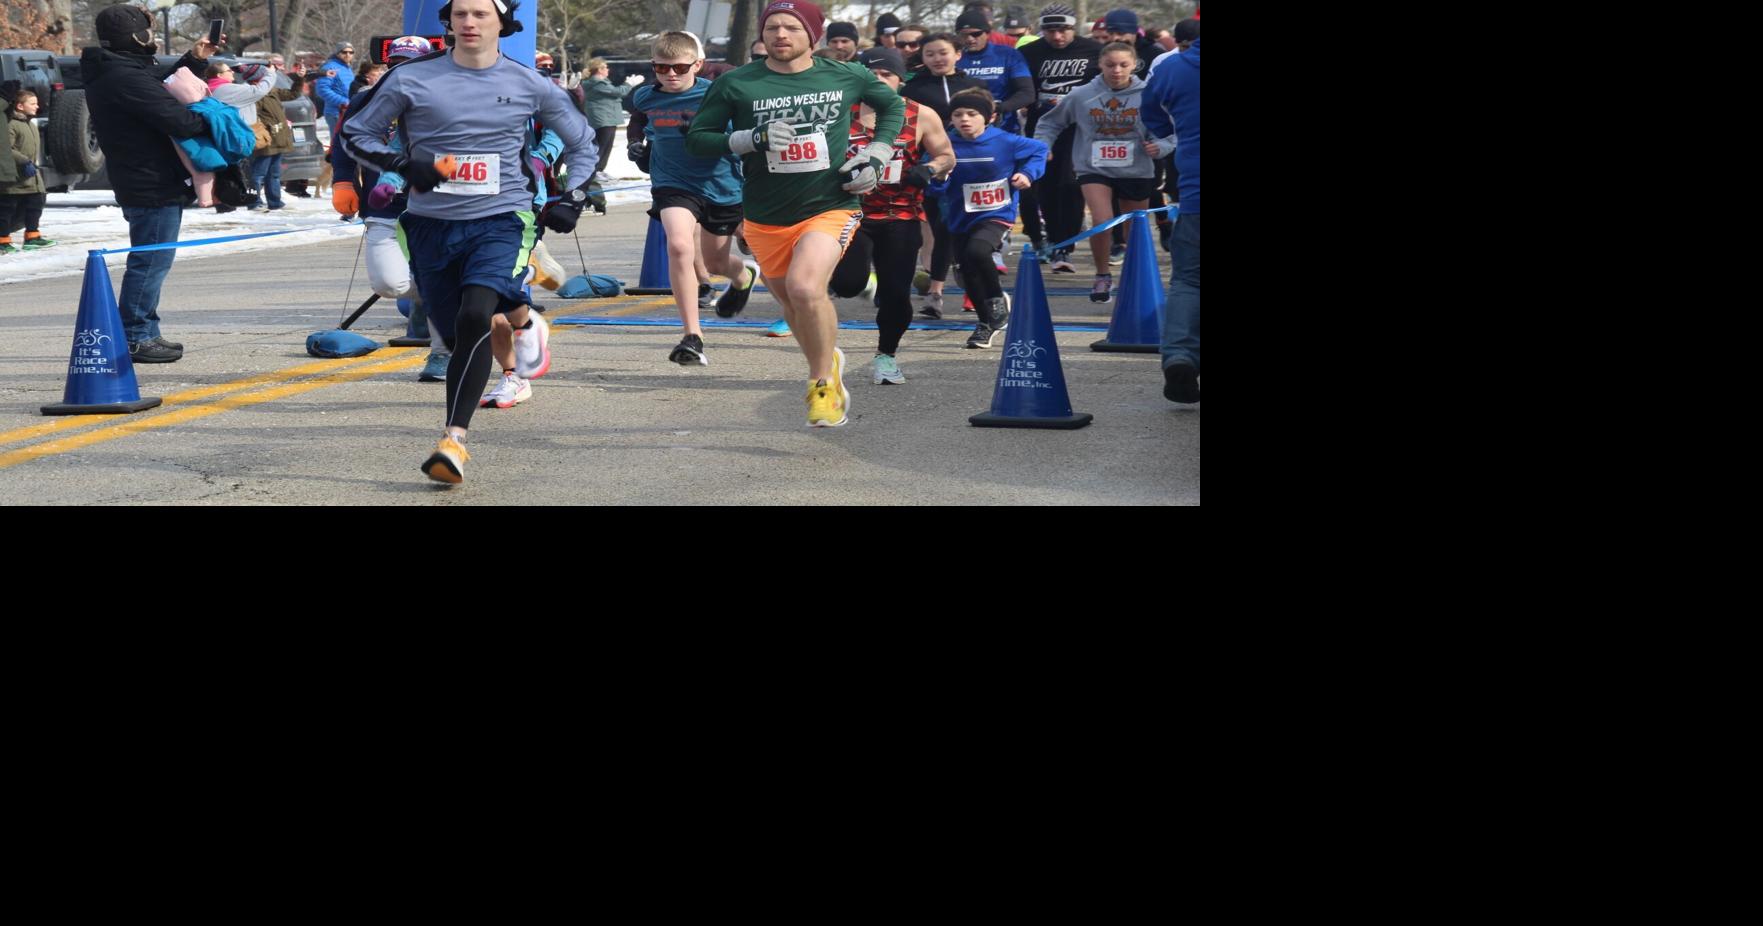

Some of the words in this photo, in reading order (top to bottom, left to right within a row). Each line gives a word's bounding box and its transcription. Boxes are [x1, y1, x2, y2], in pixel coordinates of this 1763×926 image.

[963, 67, 1005, 75] NTHERS
[1040, 59, 1089, 78] NIKE
[753, 96, 791, 111] ILLINOIS
[793, 90, 843, 106] WESLEYAN
[753, 102, 841, 127] TITANS
[1099, 146, 1127, 159] 156
[971, 188, 1005, 205] 450
[79, 348, 101, 356] It's
[75, 357, 107, 365] Race
[1011, 359, 1037, 369] It's
[1006, 369, 1042, 378] Race
